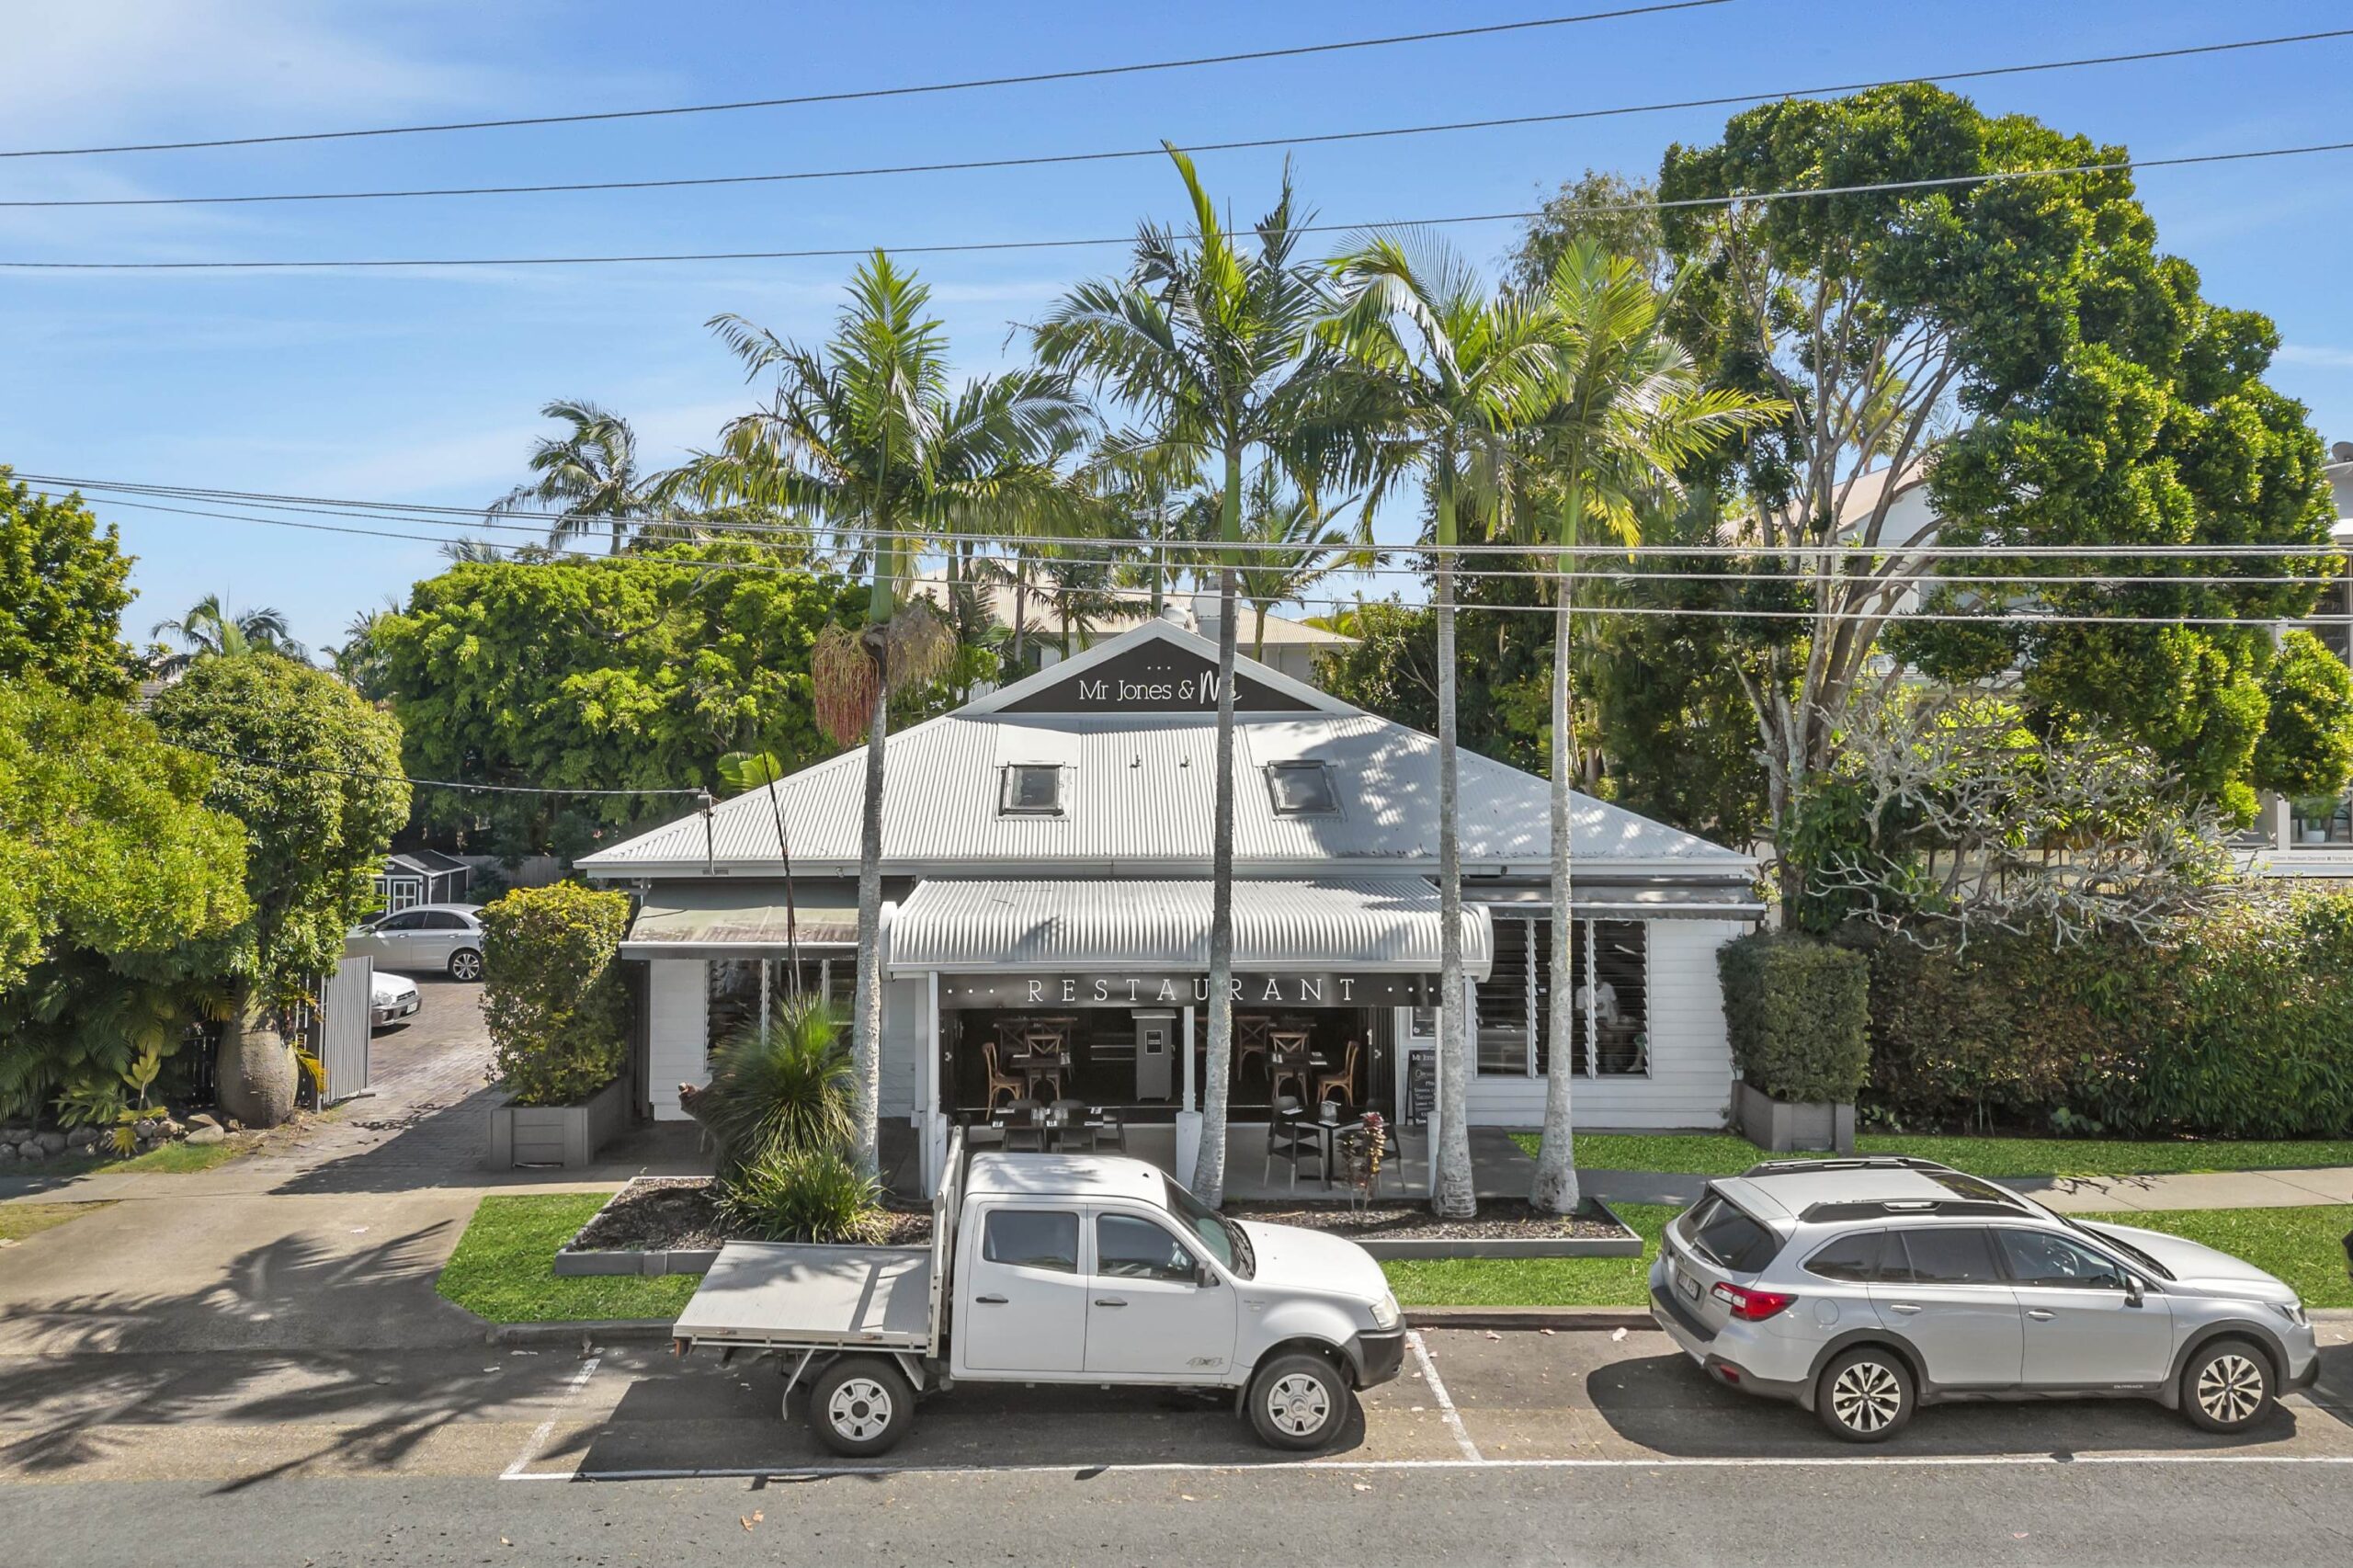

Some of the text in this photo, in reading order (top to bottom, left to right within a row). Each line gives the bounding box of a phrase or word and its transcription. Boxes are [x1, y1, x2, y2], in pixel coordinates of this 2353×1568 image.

[1079, 680, 1108, 699] Mr
[1117, 680, 1172, 701] Jones
[1178, 679, 1195, 699] &
[1028, 979, 1354, 1002] RESTAURANT
